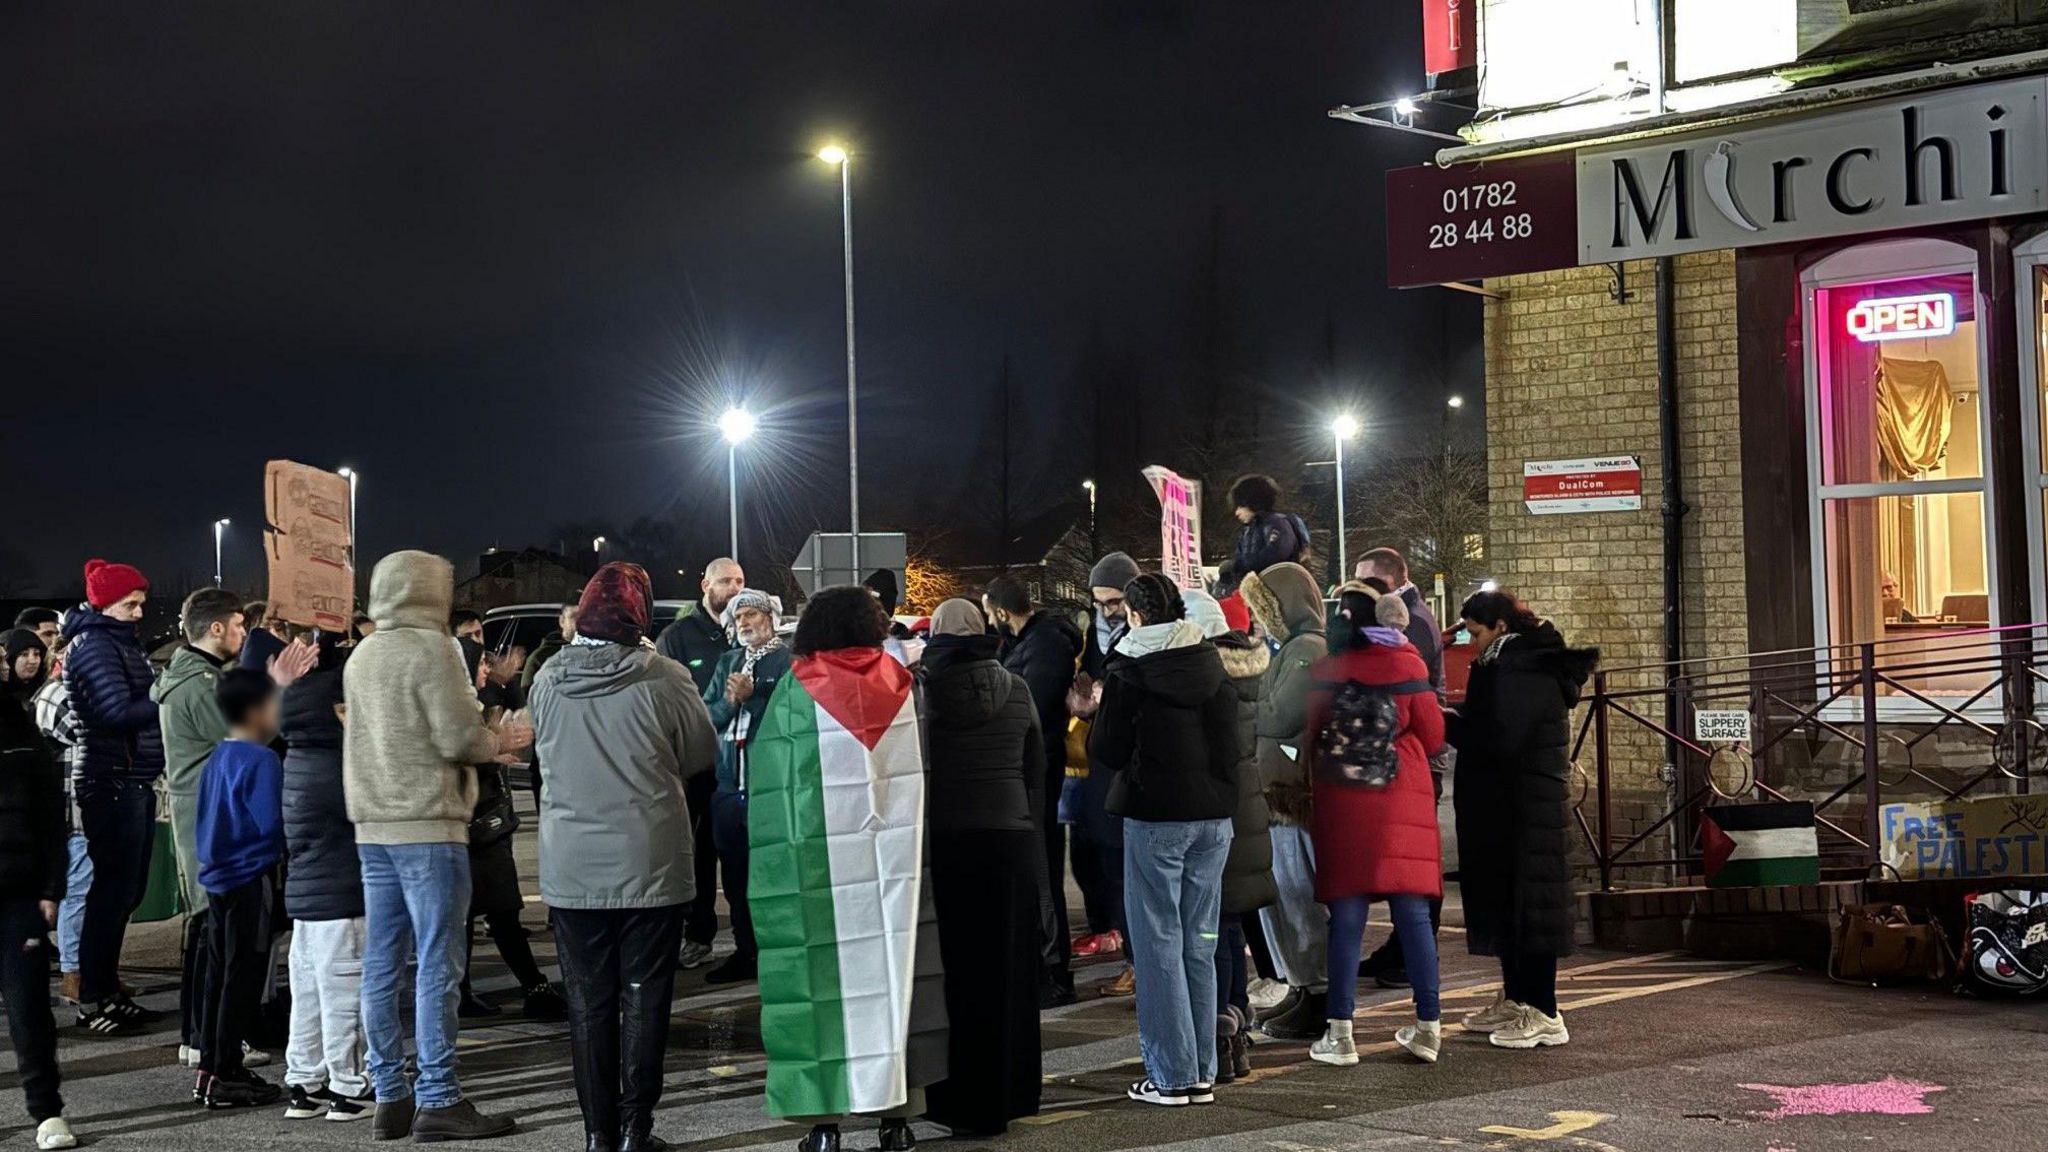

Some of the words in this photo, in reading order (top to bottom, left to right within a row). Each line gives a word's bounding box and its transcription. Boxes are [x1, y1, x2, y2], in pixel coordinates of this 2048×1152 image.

[1443, 181, 1516, 213] 01782
[1429, 223, 1458, 249] 28
[1465, 218, 1494, 243] 44
[1503, 213, 1532, 239] 88
[1847, 300, 1944, 336] OPEN
[1559, 480, 1604, 490] DualCom
[1699, 718, 1747, 728] SLIPPERY
[1701, 729, 1747, 738] SURFACE
[1885, 806, 1965, 842] FREE
